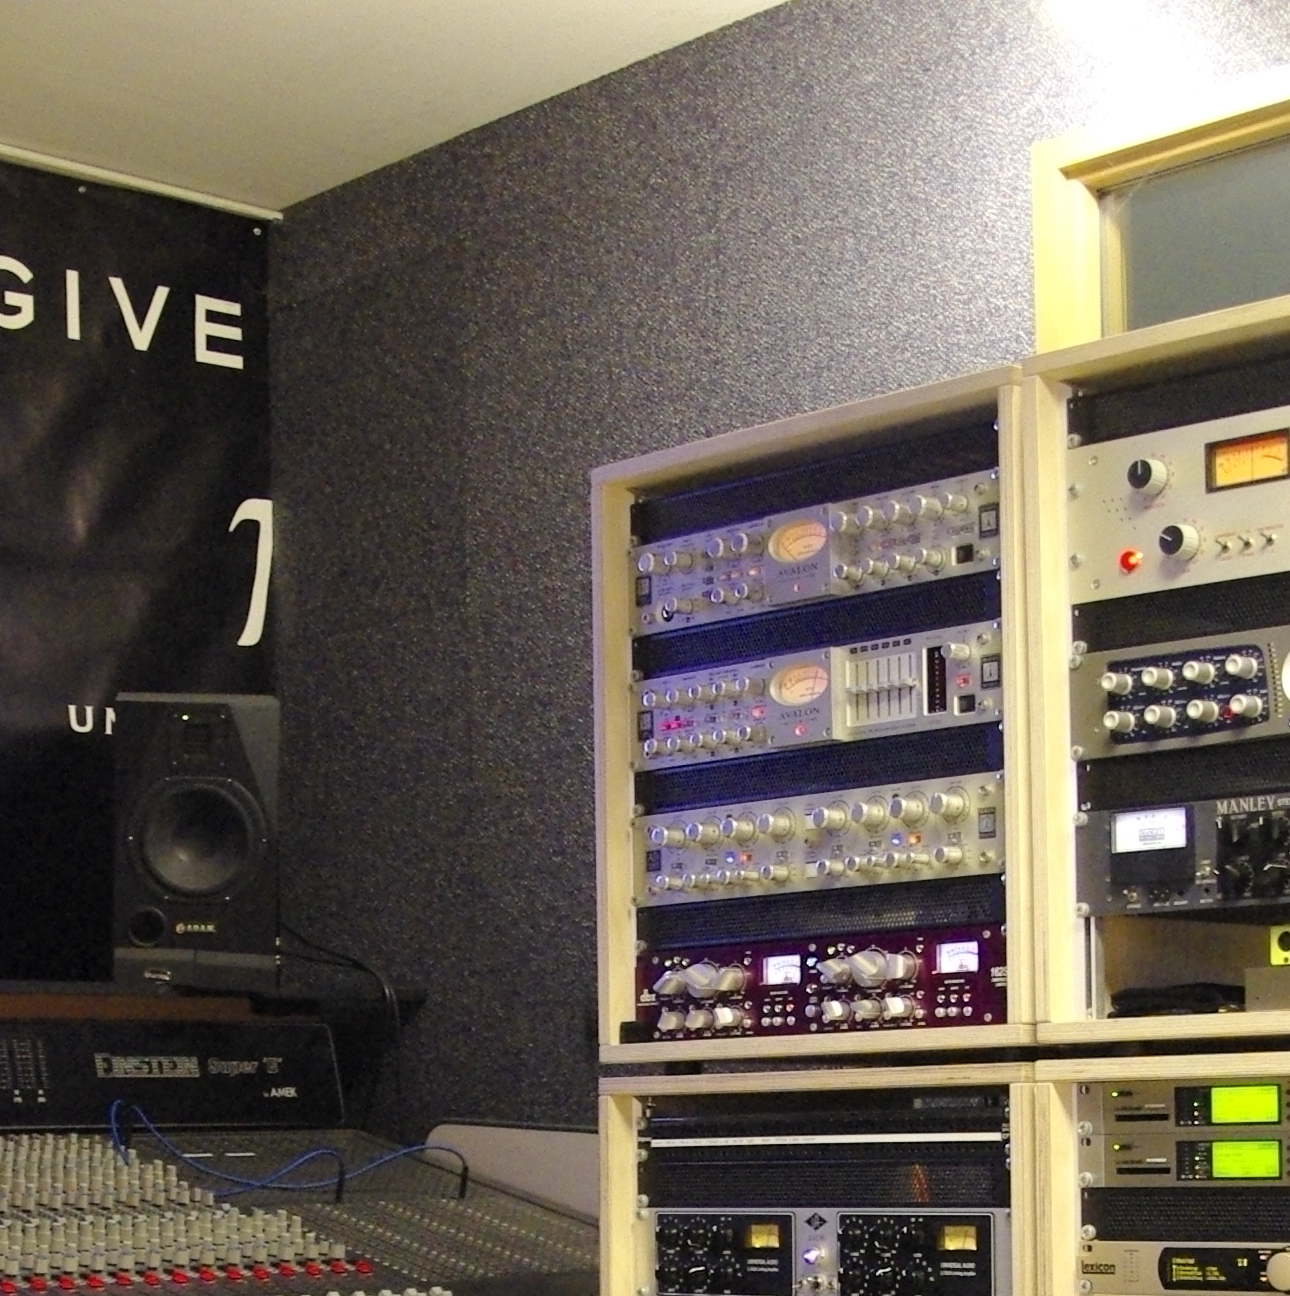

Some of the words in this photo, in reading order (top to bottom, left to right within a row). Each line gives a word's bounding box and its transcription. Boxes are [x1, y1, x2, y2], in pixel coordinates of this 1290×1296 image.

[1216, 795, 1275, 815] MANLEY
[208, 1057, 259, 1077] Super
[270, 1086, 298, 1098] AMEK
[1082, 1260, 1116, 1275] lexicon
